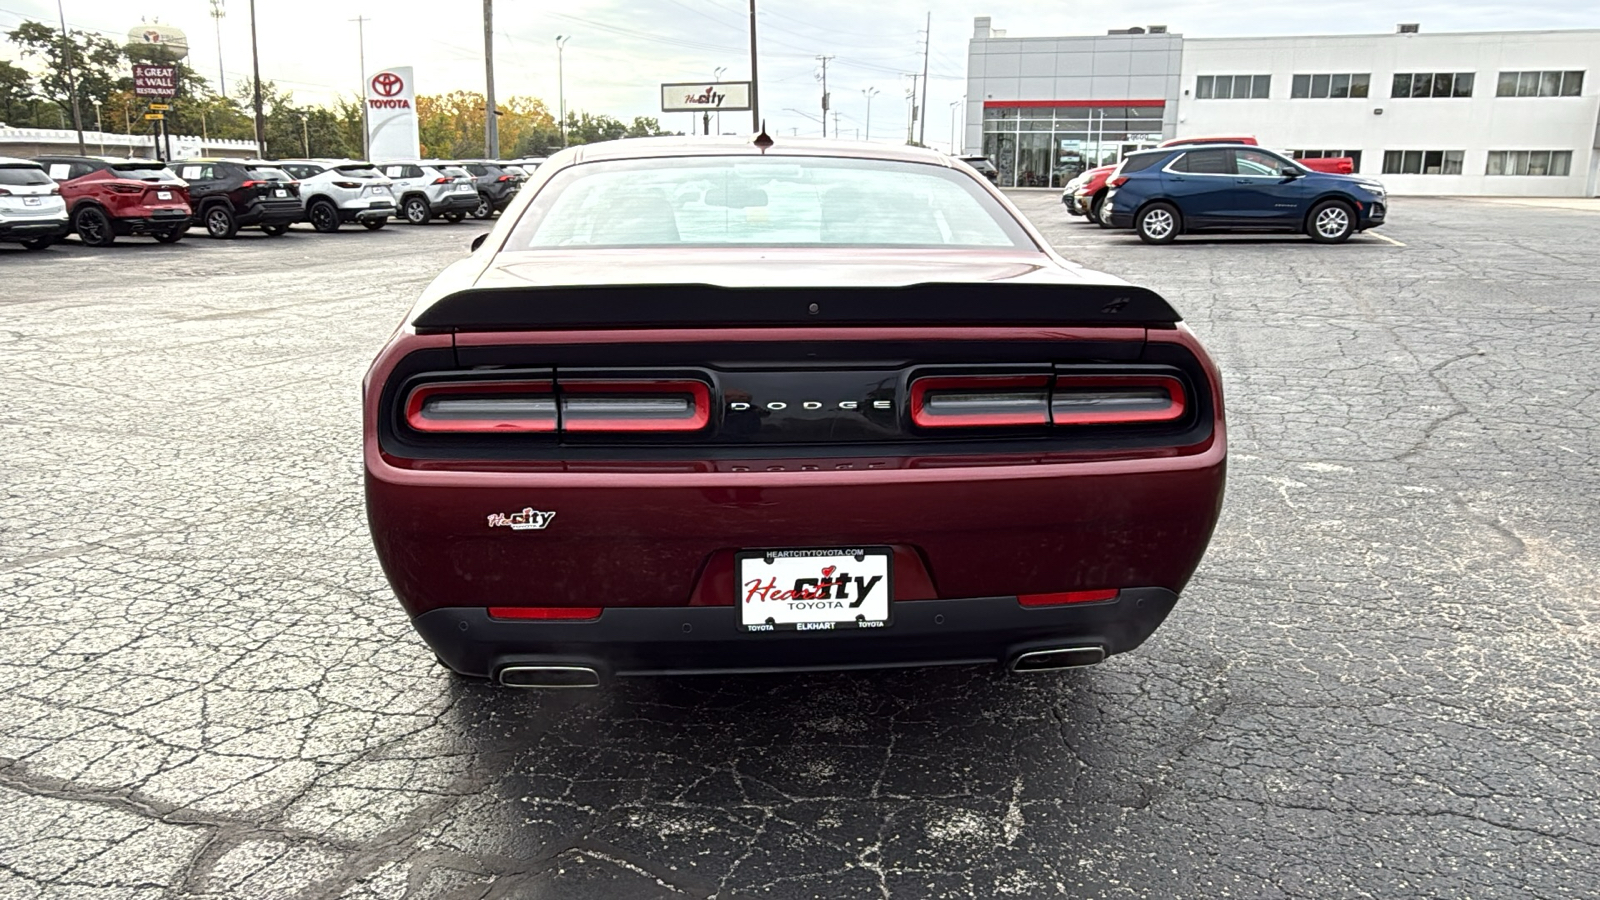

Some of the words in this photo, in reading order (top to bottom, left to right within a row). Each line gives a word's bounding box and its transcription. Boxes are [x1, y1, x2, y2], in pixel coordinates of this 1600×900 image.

[144, 67, 174, 77] GREAT
[145, 78, 173, 87] WALL
[136, 87, 176, 95] RESTAURANT
[368, 99, 410, 109] TOYOTA
[731, 401, 891, 410] DODGE
[766, 549, 864, 558] HEARTCITYTOYOTA.COM
[744, 576, 843, 604] Heart
[792, 566, 883, 608] city
[787, 601, 844, 610] TOYOTA
[748, 624, 774, 632] TOYOTA
[796, 622, 836, 631] ELKHART
[858, 621, 884, 629] TOYOTA
